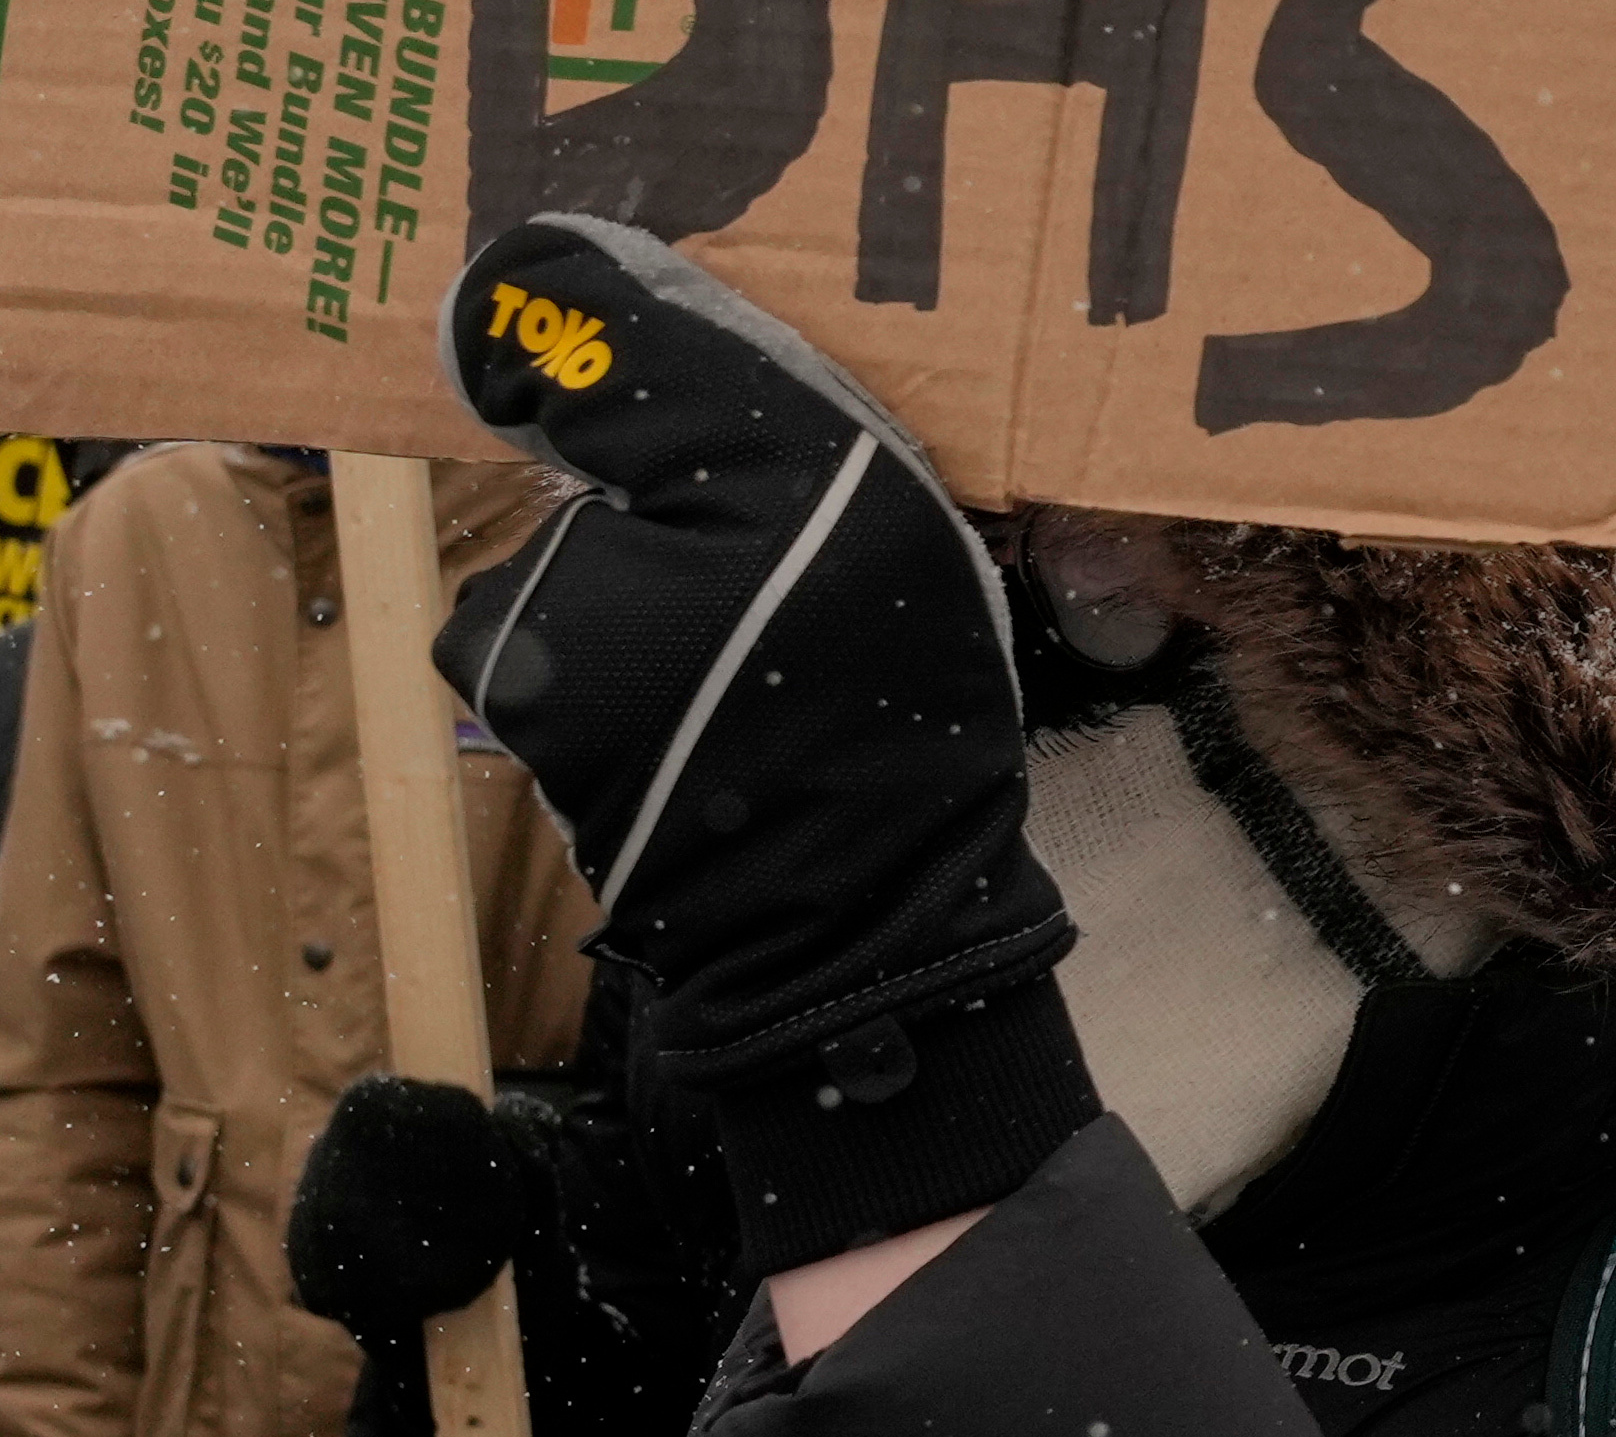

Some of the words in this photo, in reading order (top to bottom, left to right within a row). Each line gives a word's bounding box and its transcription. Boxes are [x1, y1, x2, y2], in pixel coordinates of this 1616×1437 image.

[179, 38, 226, 137] $20
[168, 151, 204, 212] in
[212, 105, 267, 250] We'll
[262, 50, 325, 256] Bundle
[306, 135, 369, 344] MORE!
[1272, 1342, 1406, 1391] mot
